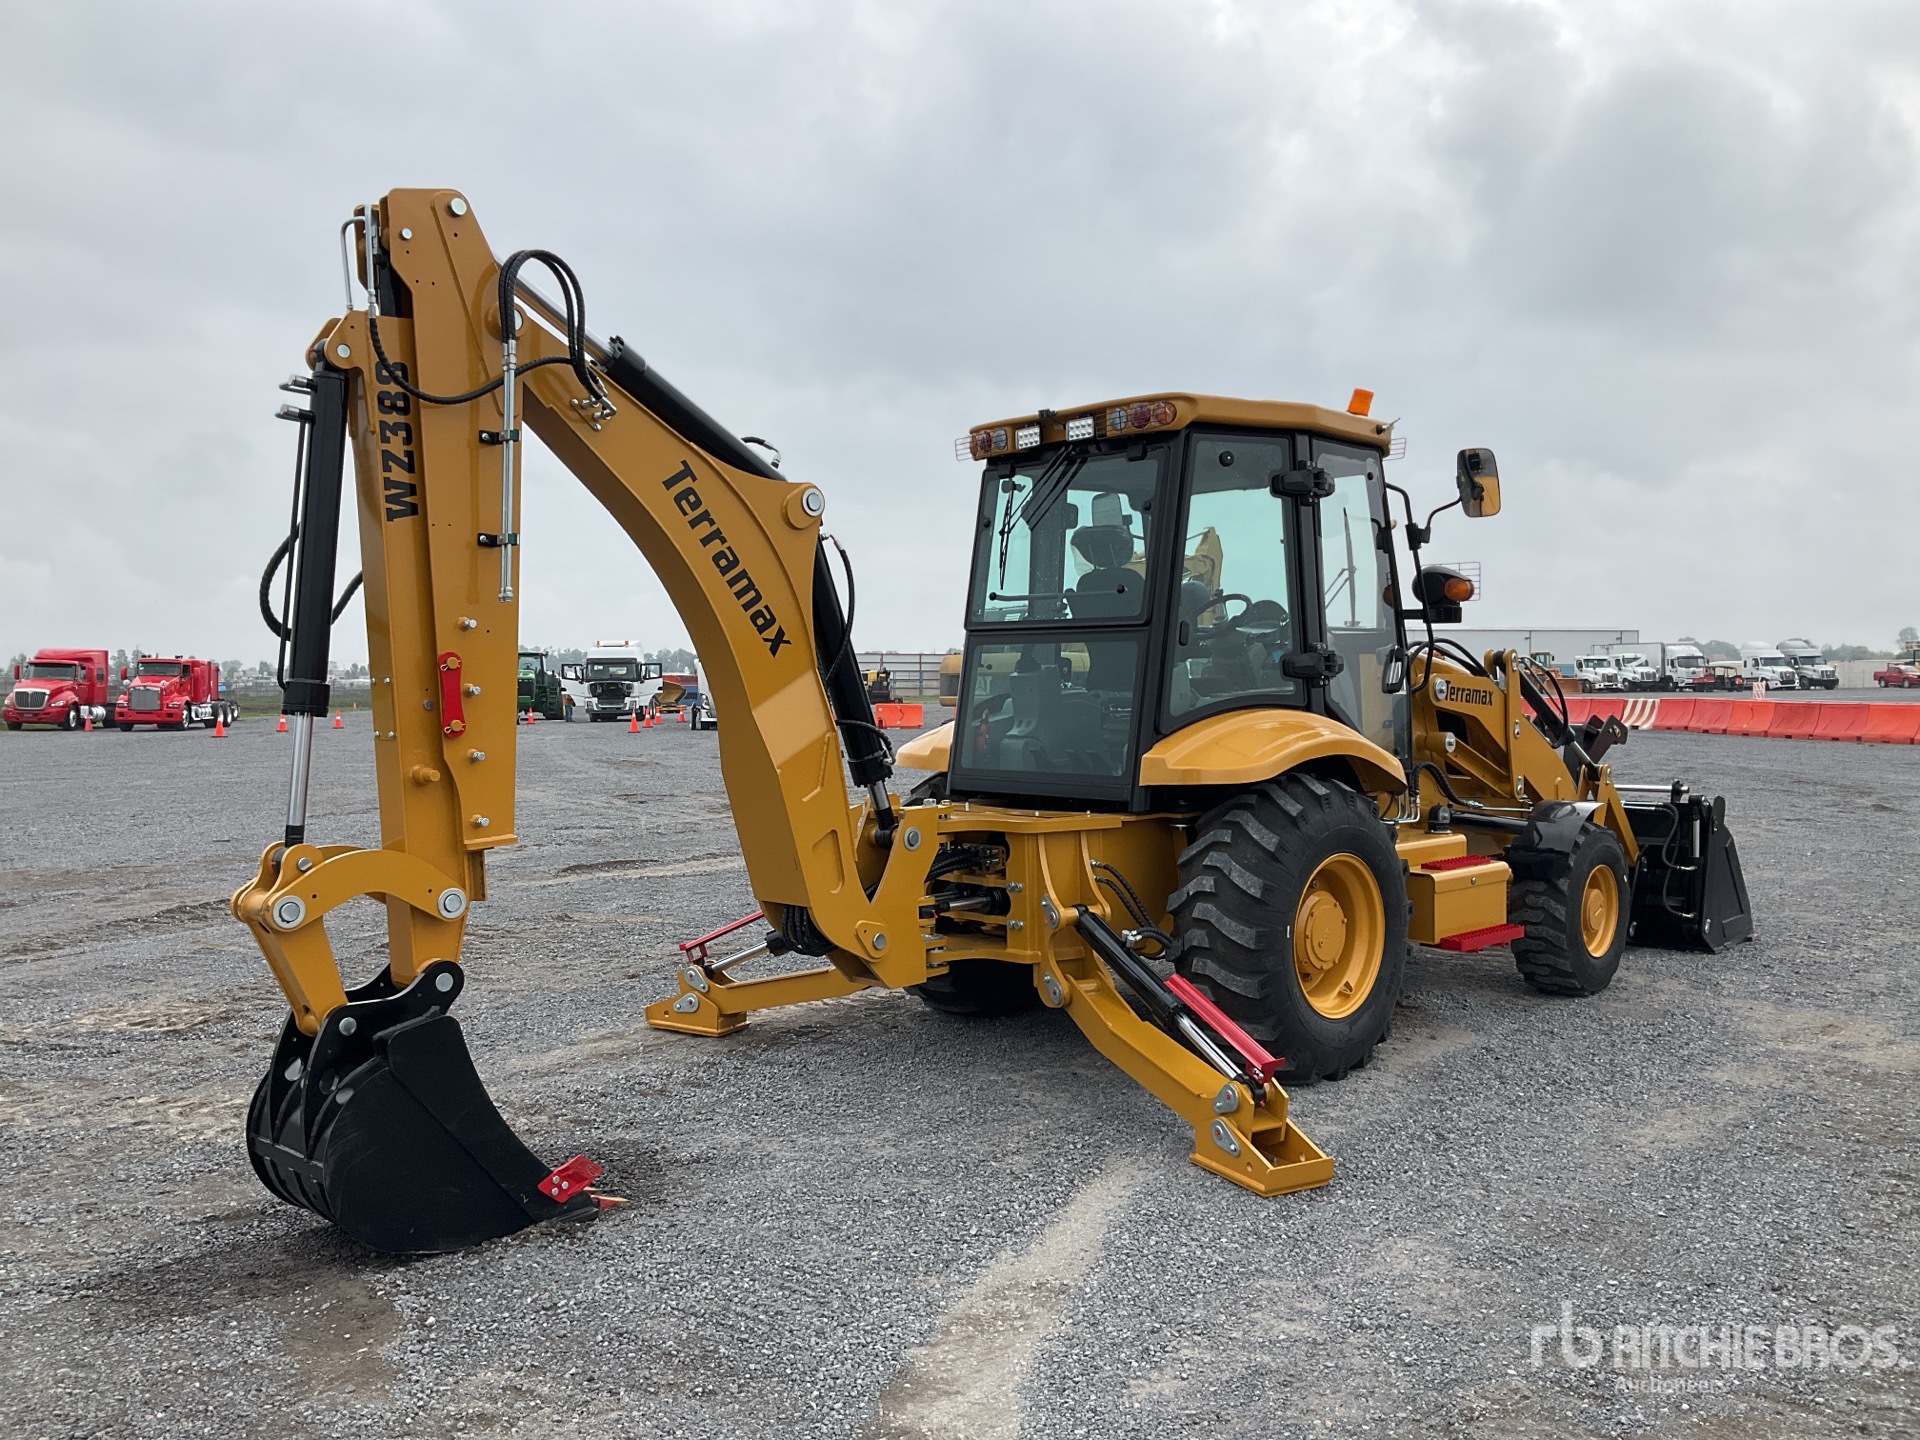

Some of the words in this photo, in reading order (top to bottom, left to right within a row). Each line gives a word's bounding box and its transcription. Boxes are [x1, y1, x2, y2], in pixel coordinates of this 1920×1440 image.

[375, 360, 419, 522] WZ388
[661, 459, 792, 658] Terramax
[974, 675, 993, 696] AT
[1445, 680, 1494, 706] Terramax
